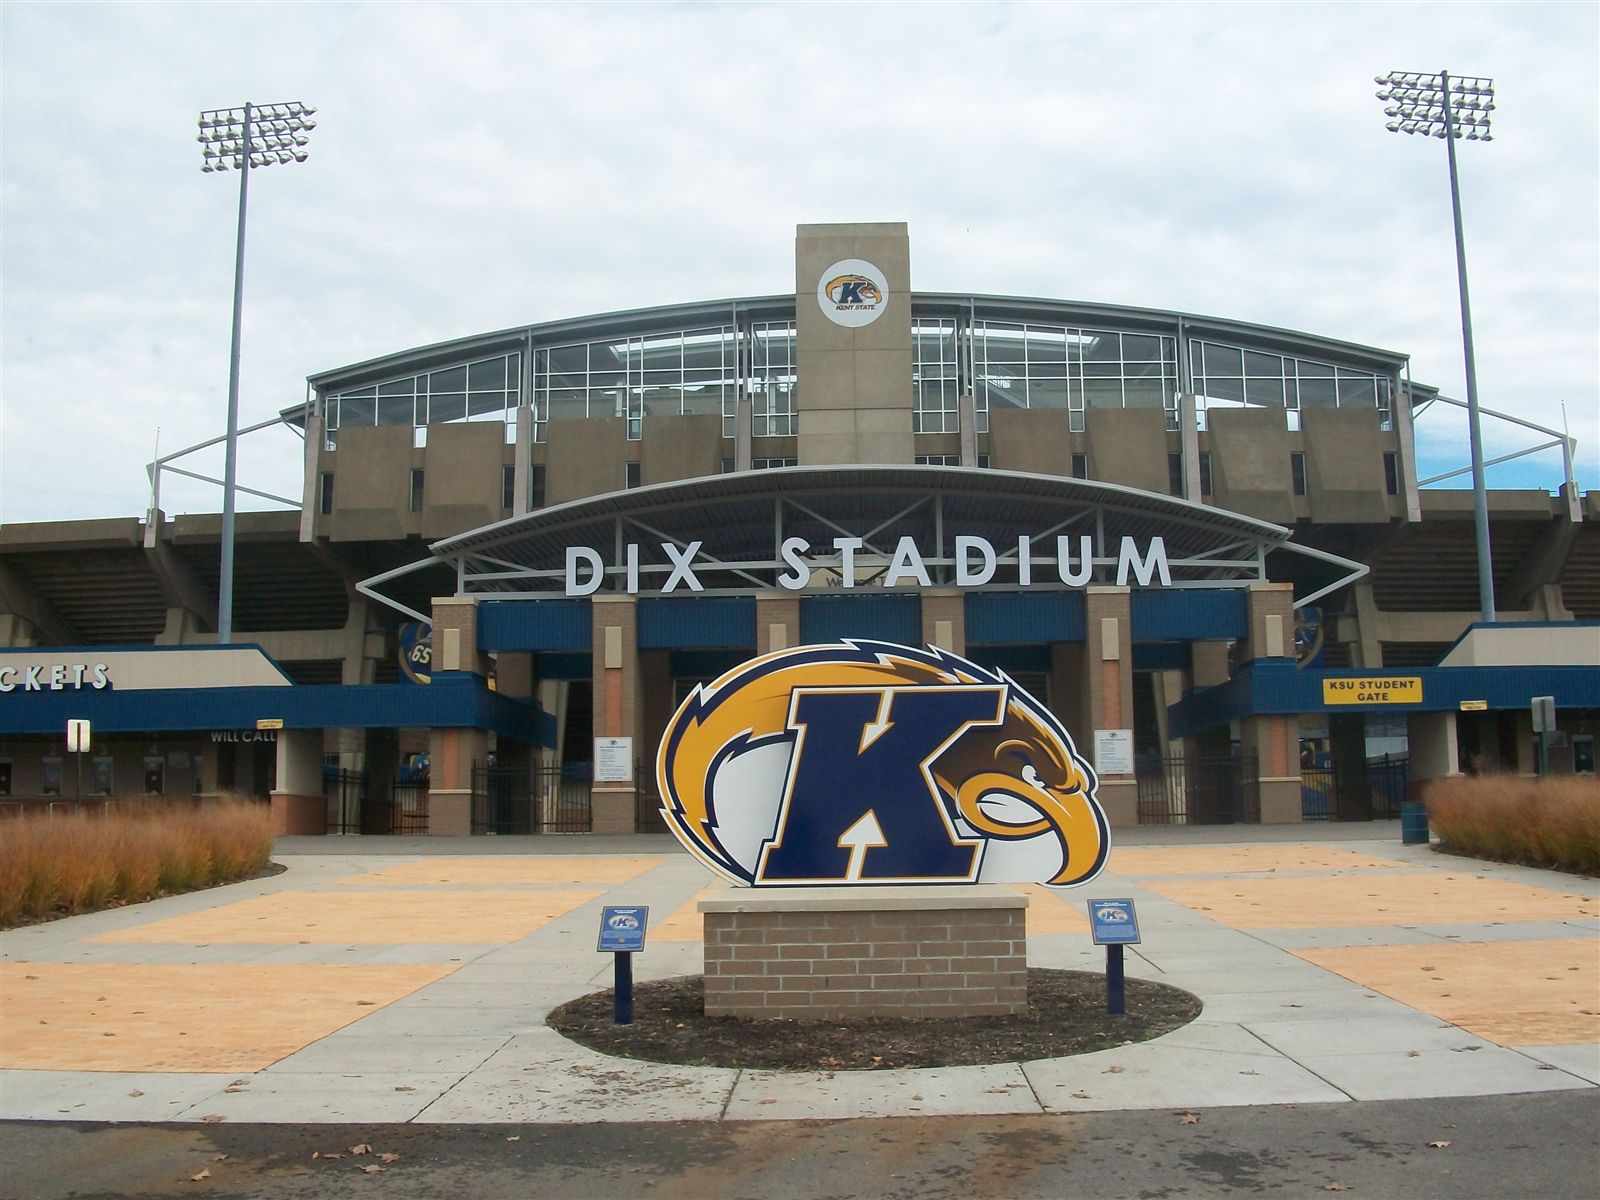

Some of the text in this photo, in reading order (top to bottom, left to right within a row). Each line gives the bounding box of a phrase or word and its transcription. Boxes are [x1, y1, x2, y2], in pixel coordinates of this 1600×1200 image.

[565, 535, 1172, 597] DIX STADIUM
[411, 644, 432, 664] 65
[0, 663, 109, 692] CKETS
[1329, 680, 1415, 690] KSU STUDENT
[1357, 693, 1389, 702] GATE
[211, 731, 276, 743] WILL CALL
[754, 685, 1009, 887] K
